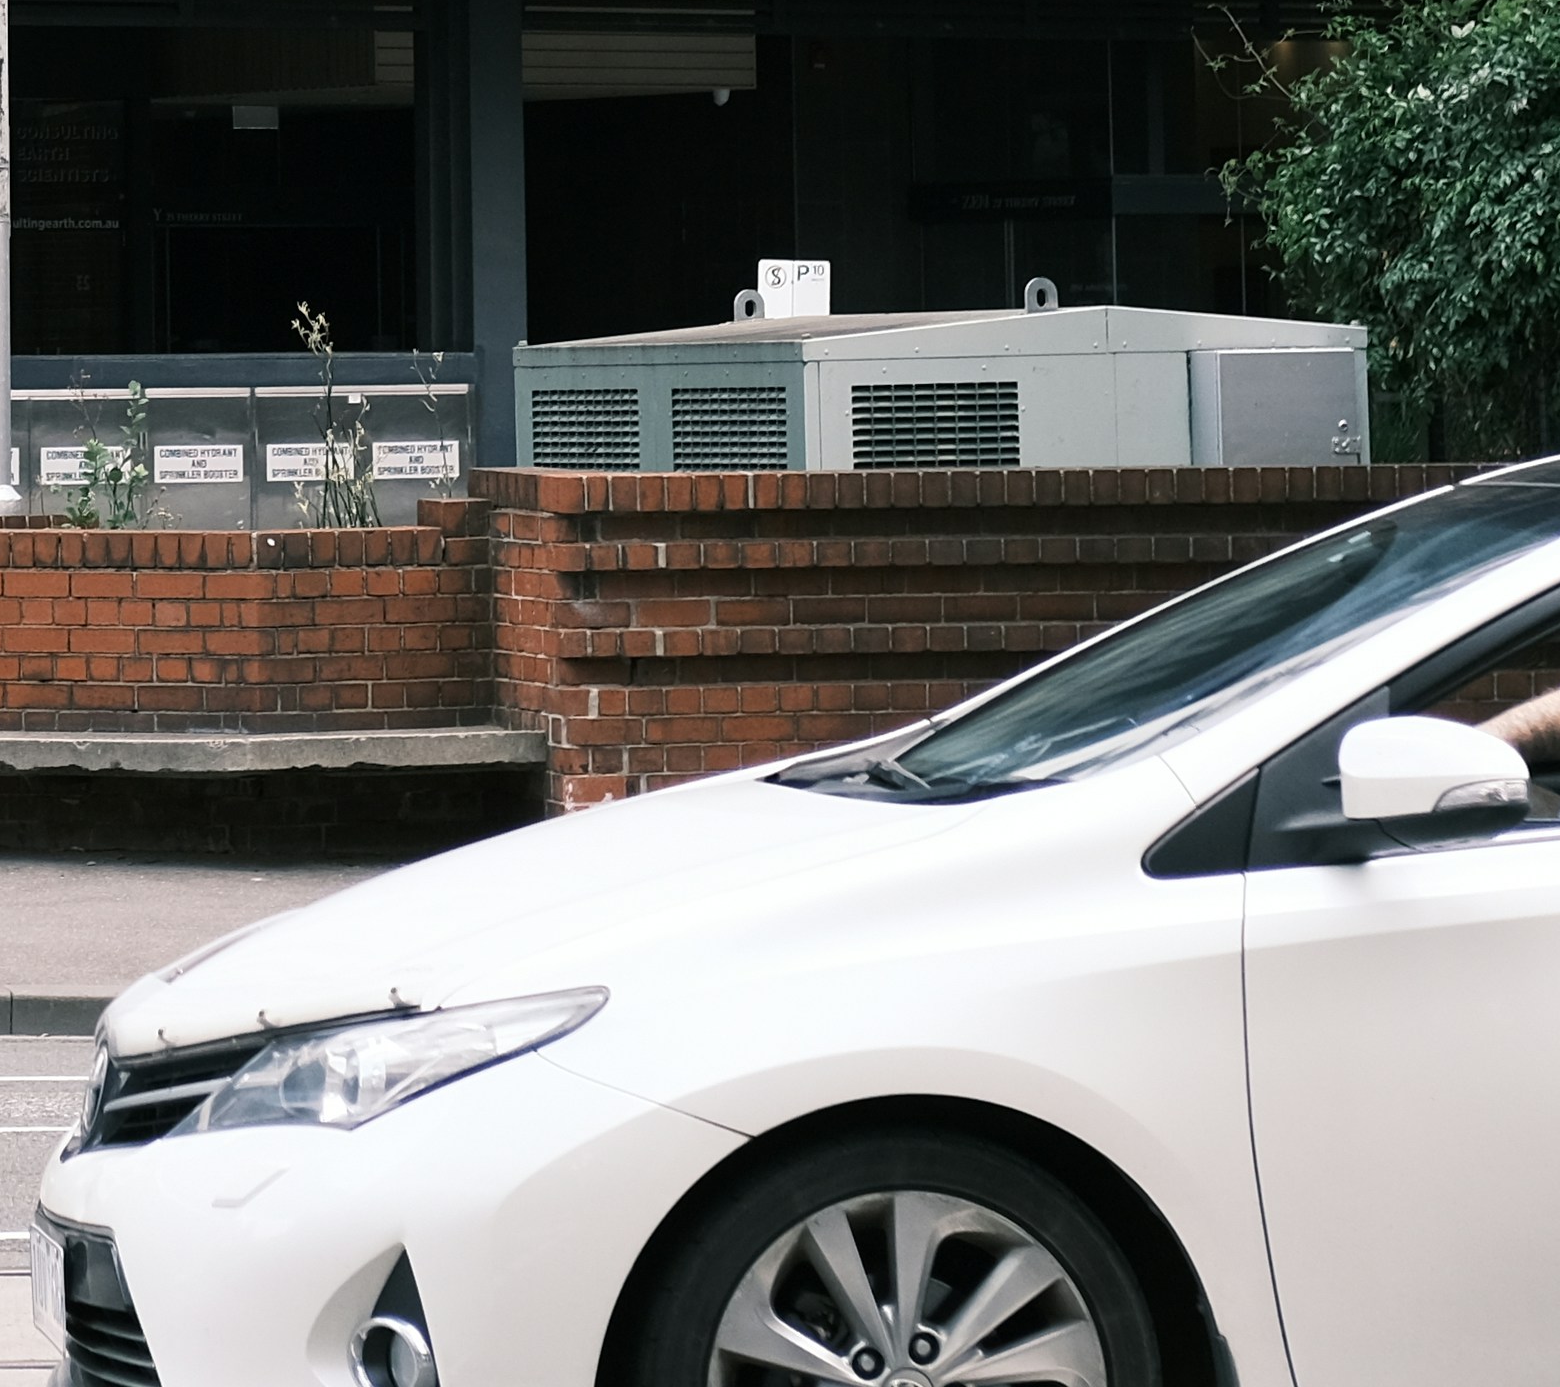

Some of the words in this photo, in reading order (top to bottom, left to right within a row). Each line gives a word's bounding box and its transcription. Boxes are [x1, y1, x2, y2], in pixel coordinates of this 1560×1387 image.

[12, 217, 120, 231] ultingearth.com.au
[159, 449, 198, 459] COMBINED
[200, 448, 238, 457] HYDRANT
[272, 447, 310, 457] COMBINED
[191, 460, 207, 468] AND
[159, 470, 201, 479] SPRINKLER
